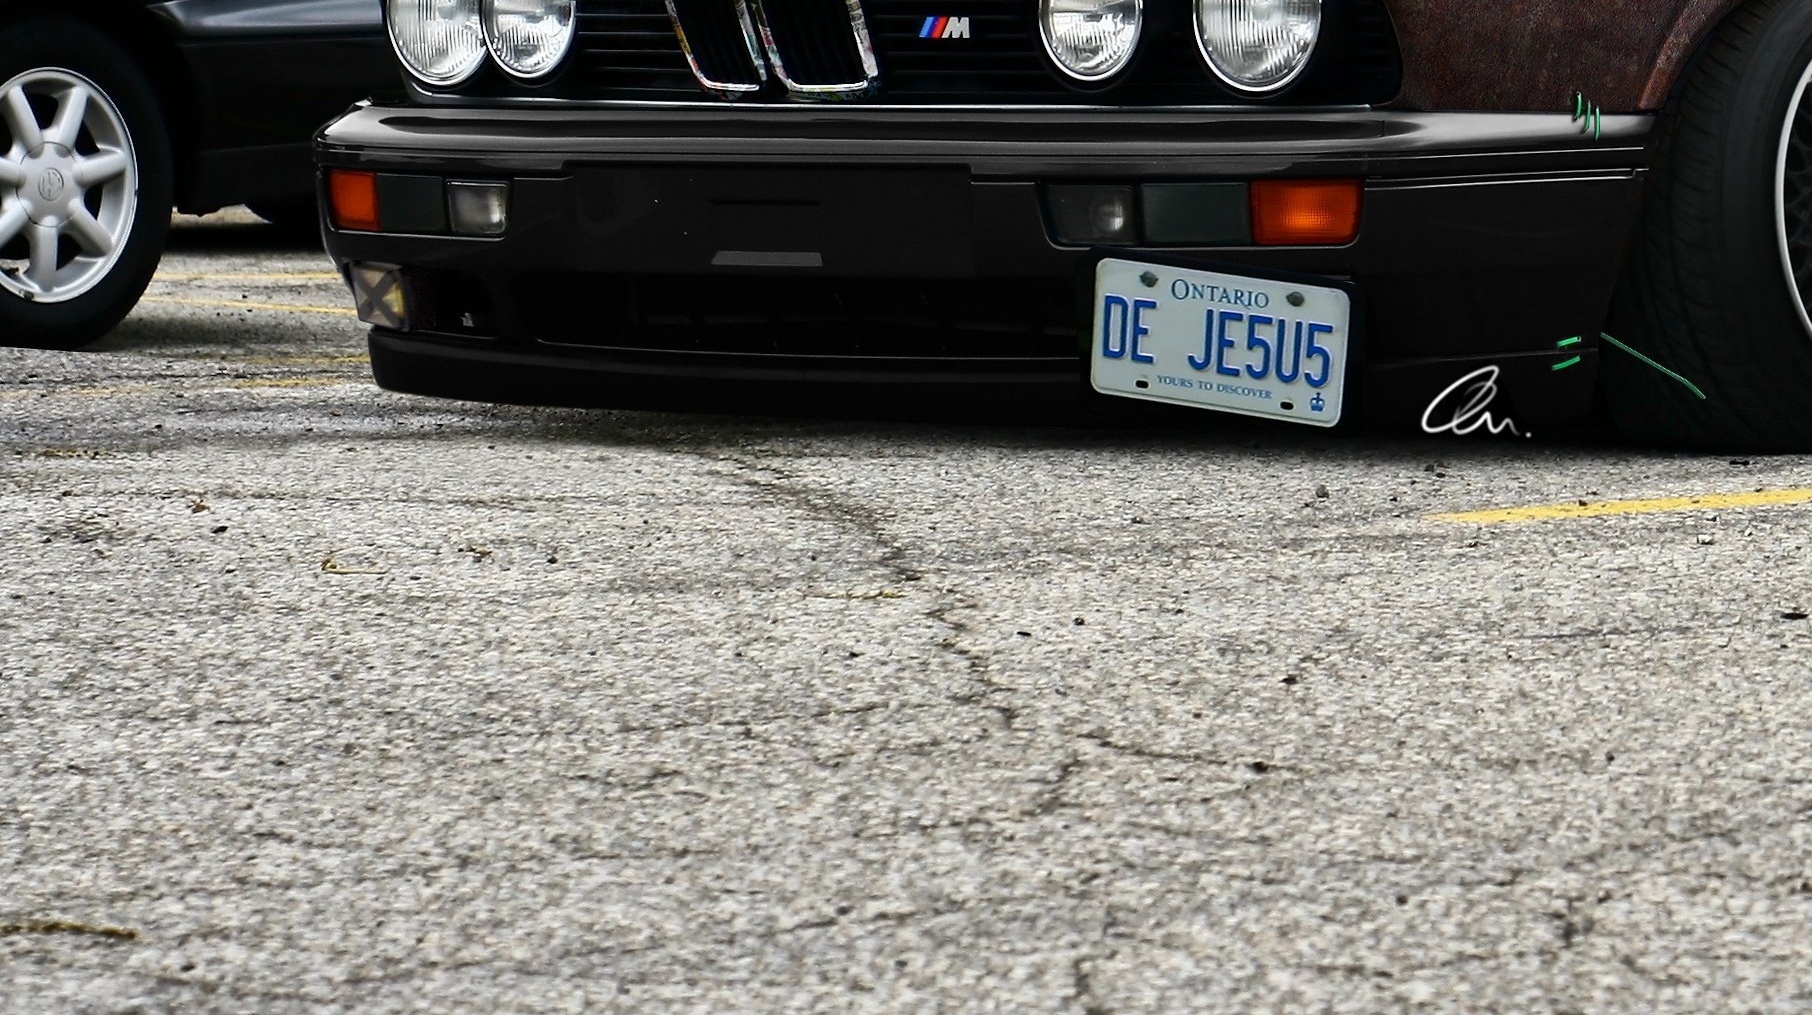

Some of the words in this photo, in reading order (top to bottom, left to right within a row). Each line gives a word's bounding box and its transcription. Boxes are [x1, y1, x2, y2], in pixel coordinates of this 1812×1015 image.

[941, 16, 971, 39] M
[1171, 279, 1269, 308] ONTARIO
[1103, 295, 1158, 364] DE
[1157, 375, 1193, 389] YOURS
[1199, 379, 1213, 391] TO
[1216, 383, 1273, 400] DISCOVER
